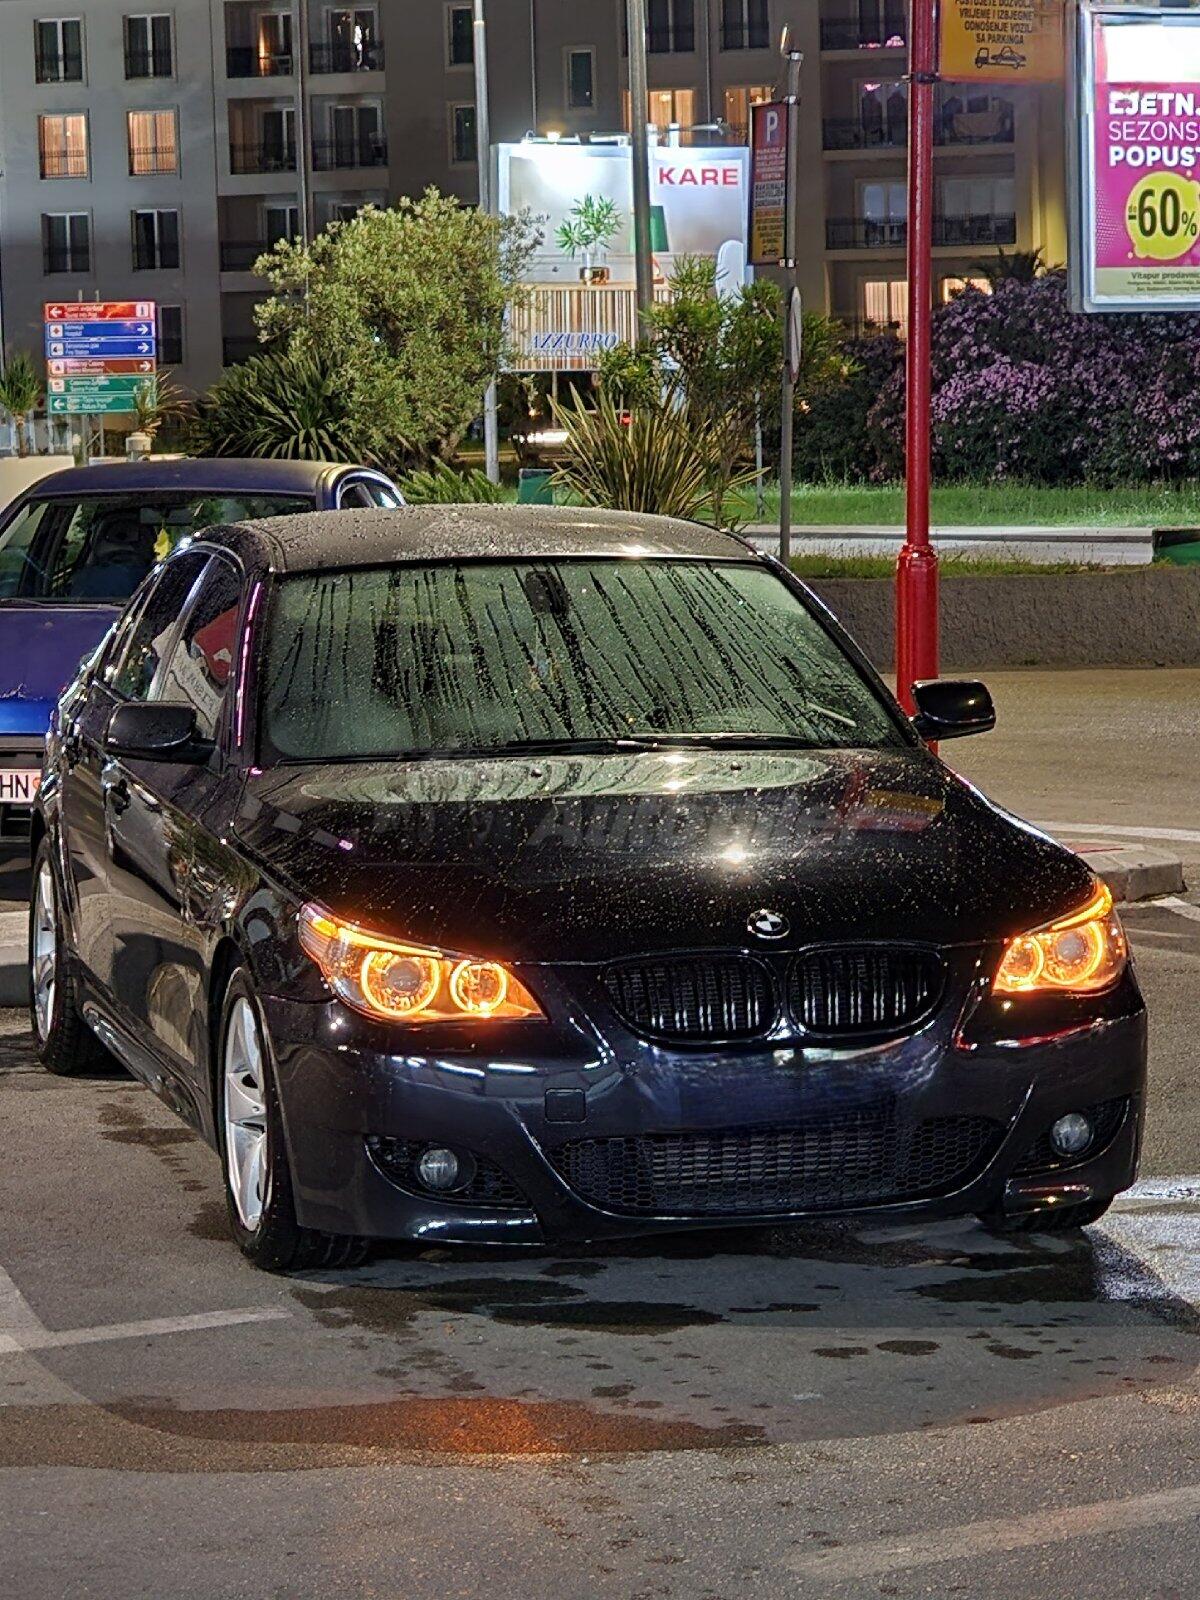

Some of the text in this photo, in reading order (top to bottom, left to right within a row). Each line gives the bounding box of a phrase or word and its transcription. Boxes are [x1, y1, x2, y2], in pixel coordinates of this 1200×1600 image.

[1010, 22, 1033, 33] VOZIL
[976, 33, 1024, 44] SA PARKINGA
[1109, 91, 1200, 116] LJETN
[766, 110, 779, 143] P
[1108, 120, 1200, 142] SEZONS
[659, 167, 738, 186] KARE
[1131, 271, 1200, 280] Vitapur prodavnic
[531, 333, 618, 350] AZZURRO
[0, 774, 29, 798] HN
